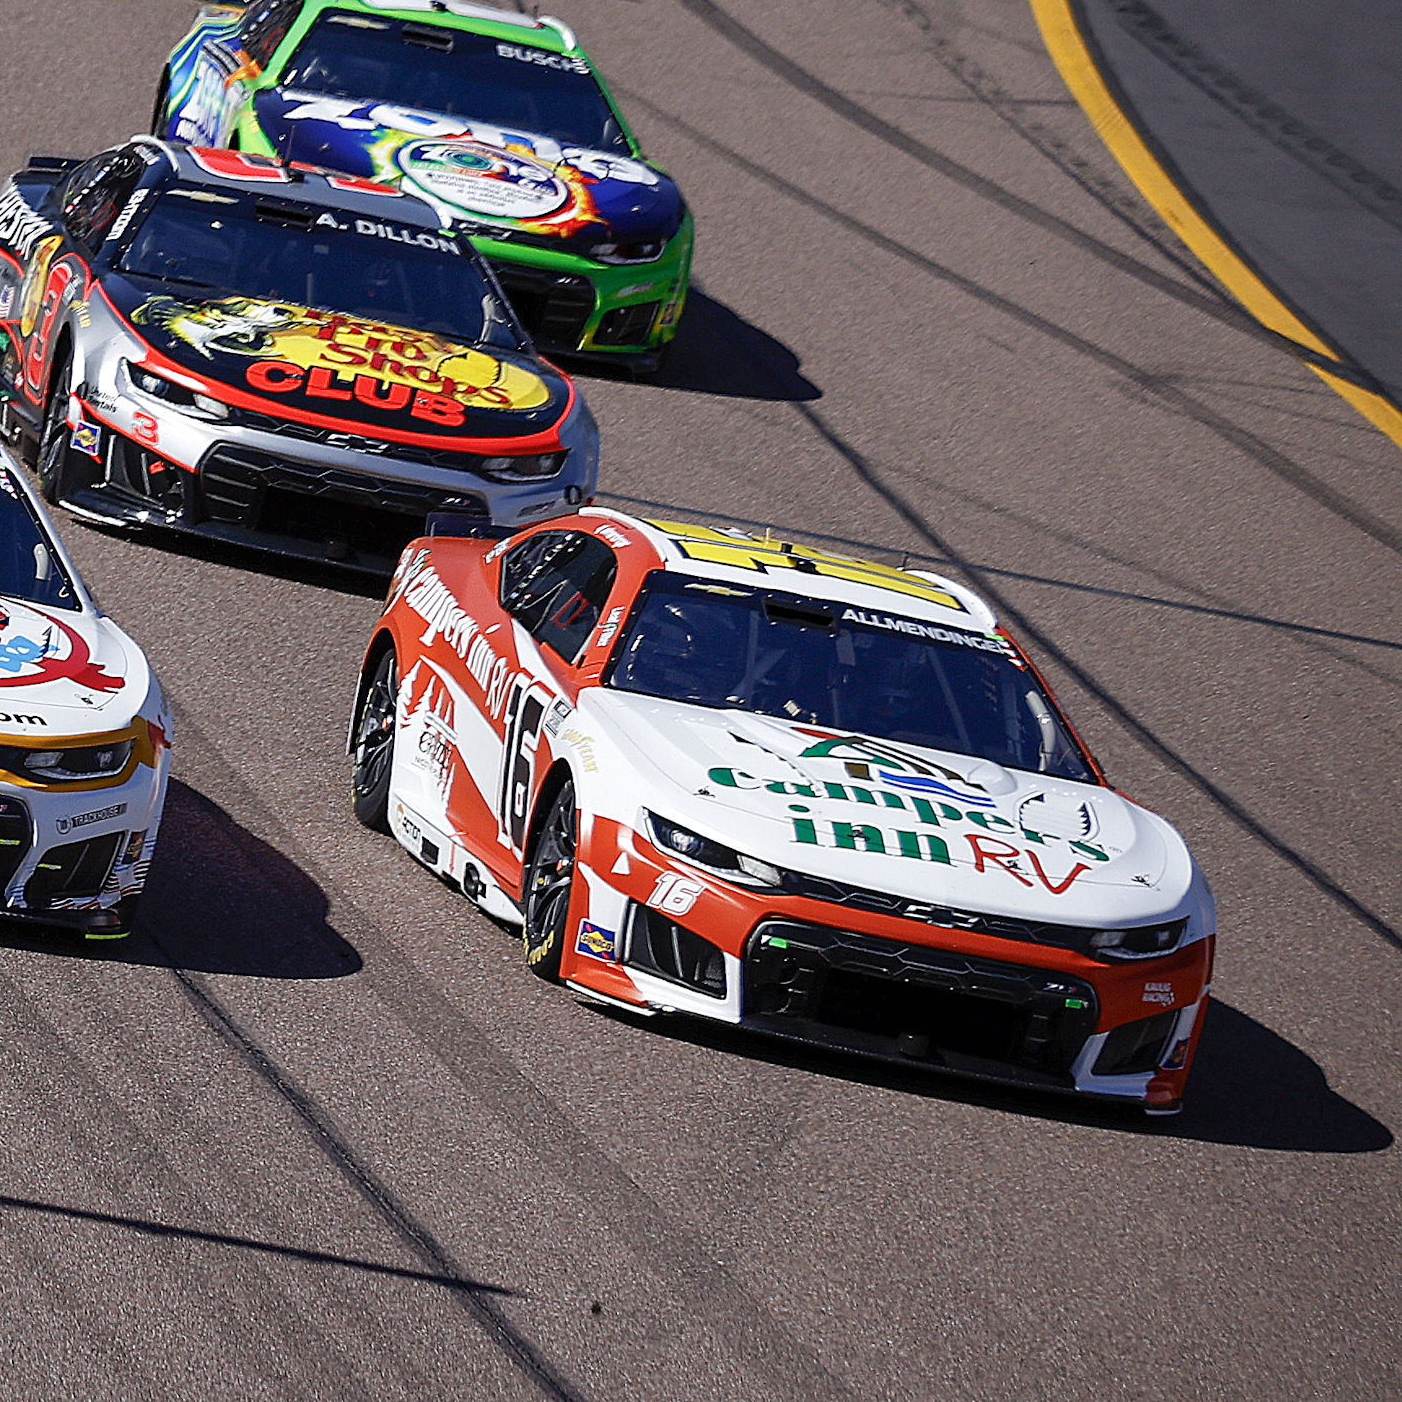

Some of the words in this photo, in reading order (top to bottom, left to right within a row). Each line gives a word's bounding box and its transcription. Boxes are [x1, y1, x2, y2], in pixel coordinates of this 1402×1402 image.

[496, 43, 589, 76] BUSCH
[314, 212, 349, 232] A.
[353, 218, 461, 256] DILLON
[245, 359, 468, 428] CLUB
[132, 411, 159, 445] 3
[402, 565, 480, 660] campers
[466, 632, 499, 693] inn
[485, 656, 515, 721] RV
[840, 607, 1014, 656] ALLMENDINGER
[496, 670, 557, 864] 16
[73, 803, 119, 827] TRACKHOUSE
[707, 765, 1112, 863] campers
[787, 803, 957, 867] inn
[964, 833, 1093, 895] RV
[645, 870, 706, 917] 16
[580, 932, 616, 953] SUNOCO
